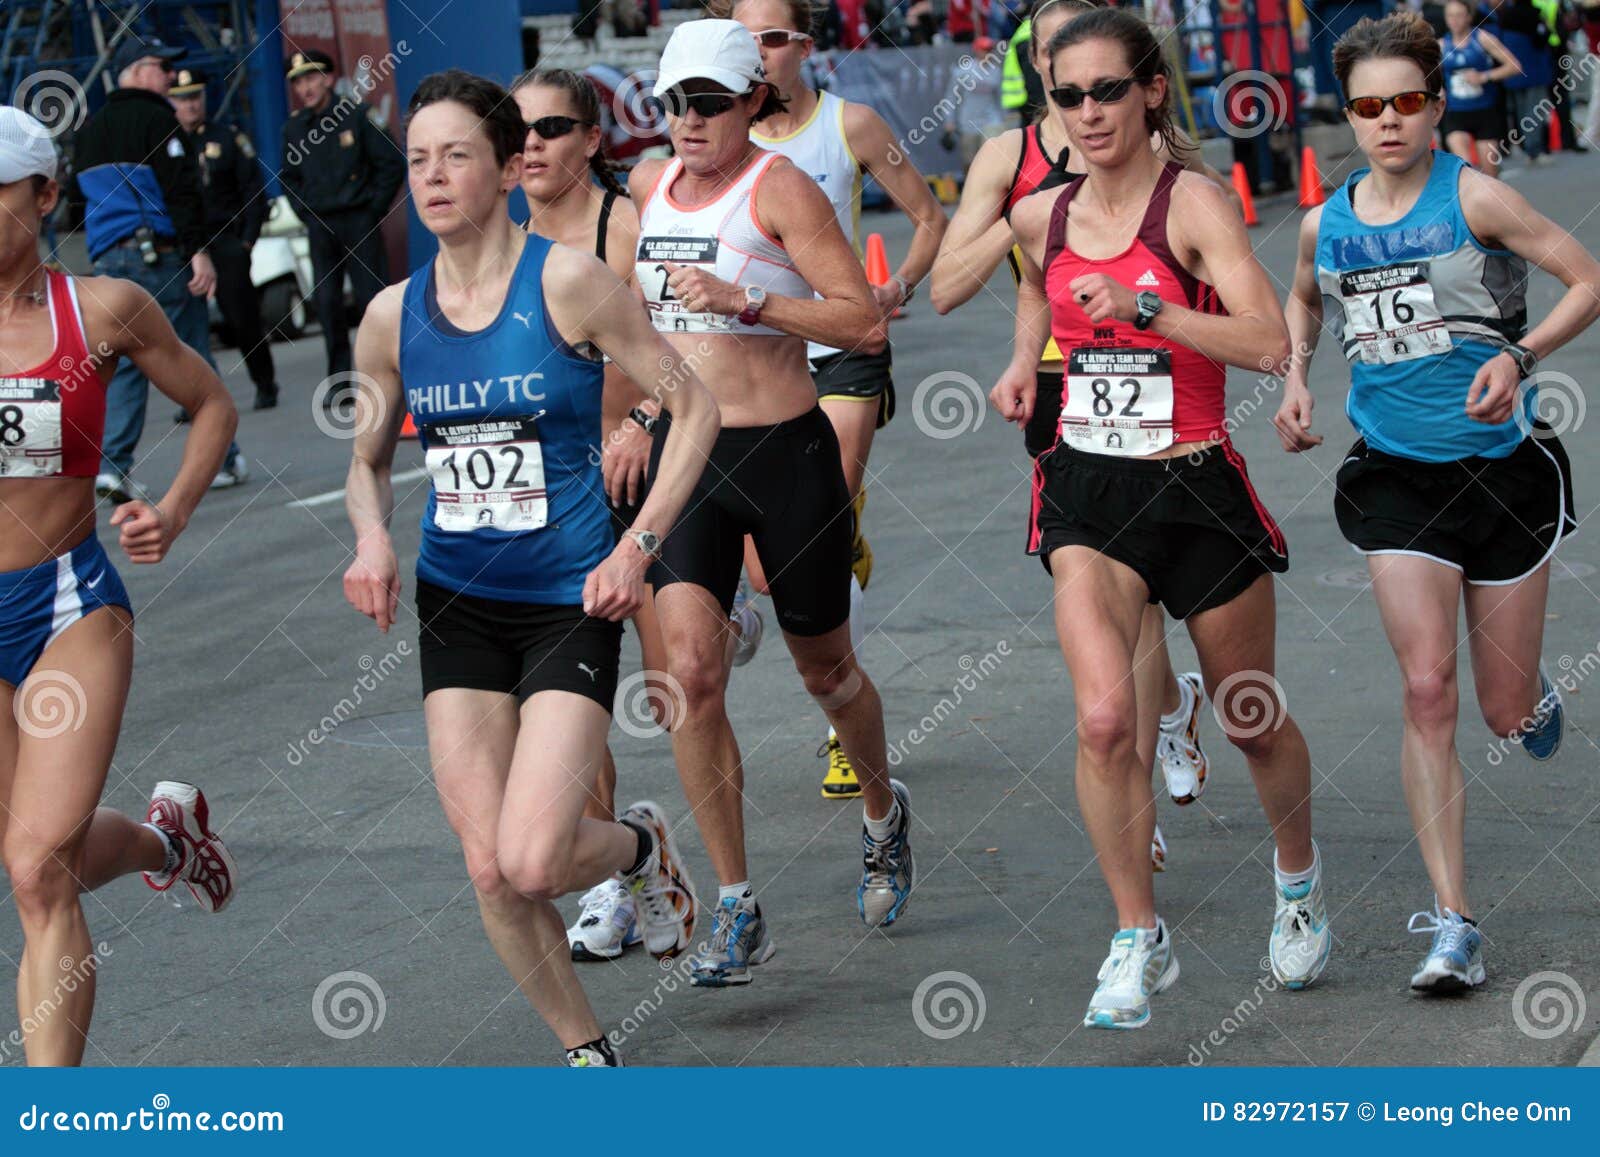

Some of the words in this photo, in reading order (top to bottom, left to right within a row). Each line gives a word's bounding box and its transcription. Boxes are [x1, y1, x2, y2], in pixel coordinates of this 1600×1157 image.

[1369, 289, 1415, 330] 16
[1116, 354, 1134, 364] TEAM
[408, 379, 494, 416] PHILLY
[499, 372, 547, 404] TC
[1091, 378, 1144, 418] 82
[442, 446, 530, 490] 102
